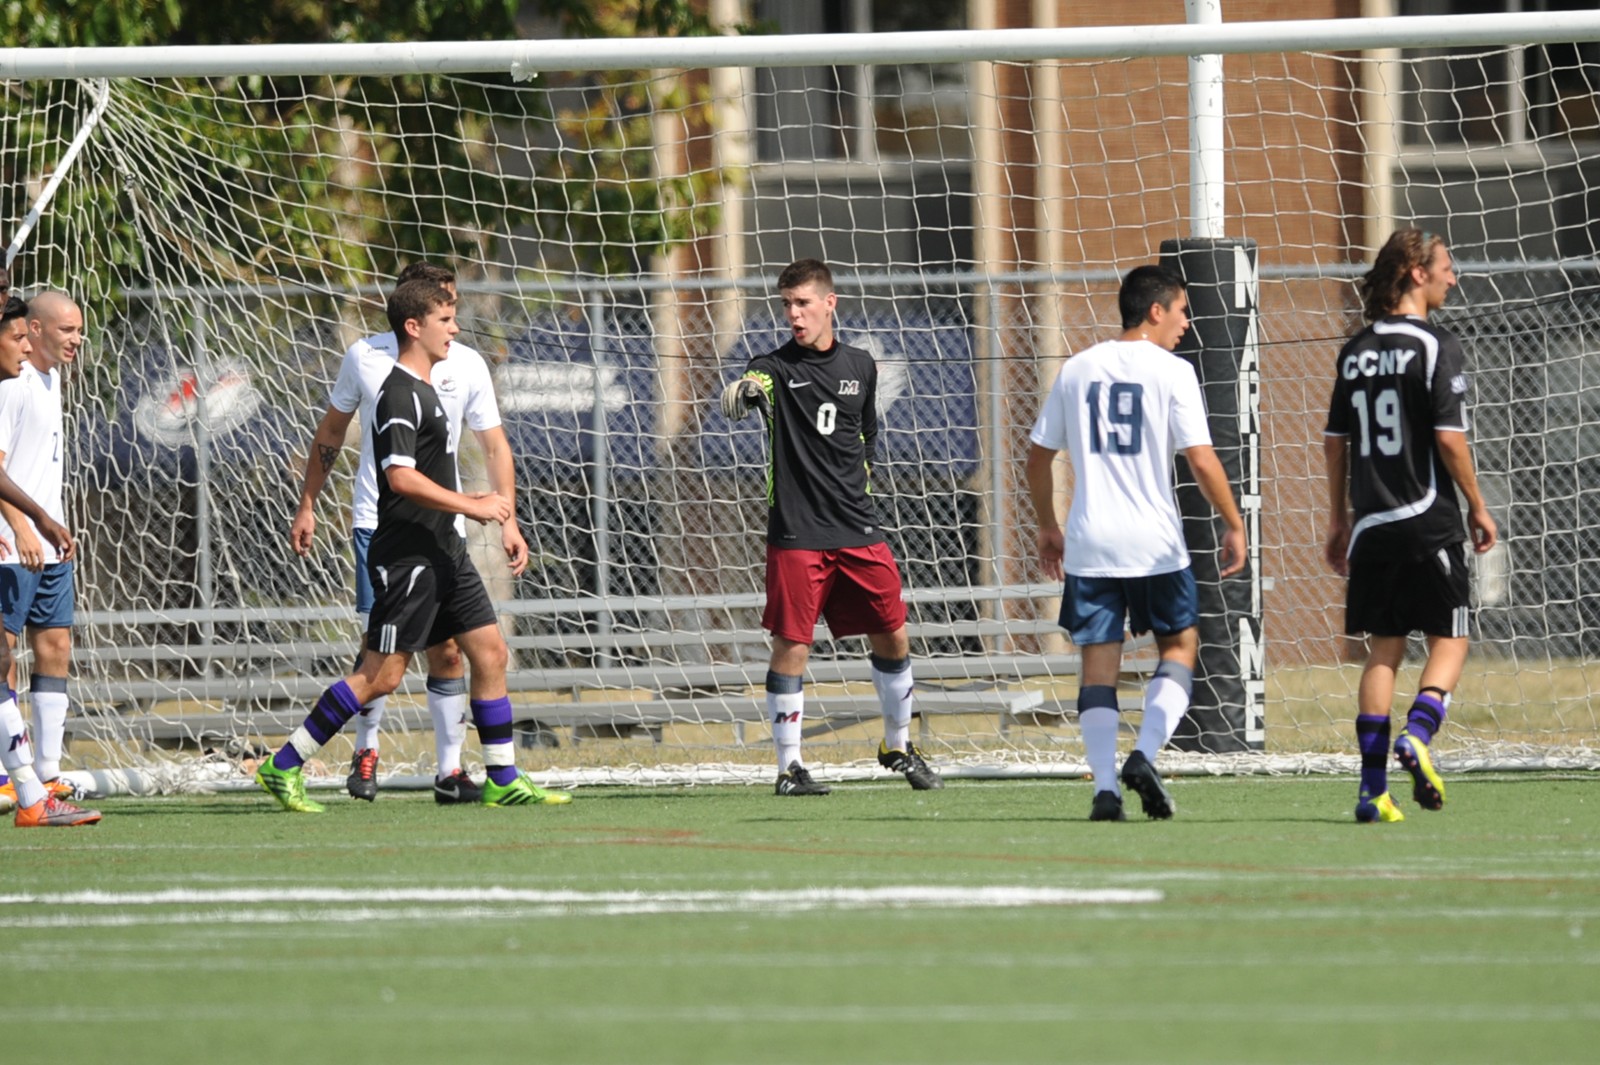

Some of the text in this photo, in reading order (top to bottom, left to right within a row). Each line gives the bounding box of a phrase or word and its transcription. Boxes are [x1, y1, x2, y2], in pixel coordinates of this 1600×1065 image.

[1343, 348, 1416, 380] CCNY
[838, 379, 859, 395] M
[817, 402, 837, 436] 0
[1086, 381, 1143, 456] 19
[1351, 388, 1402, 457] 19
[774, 710, 800, 724] M
